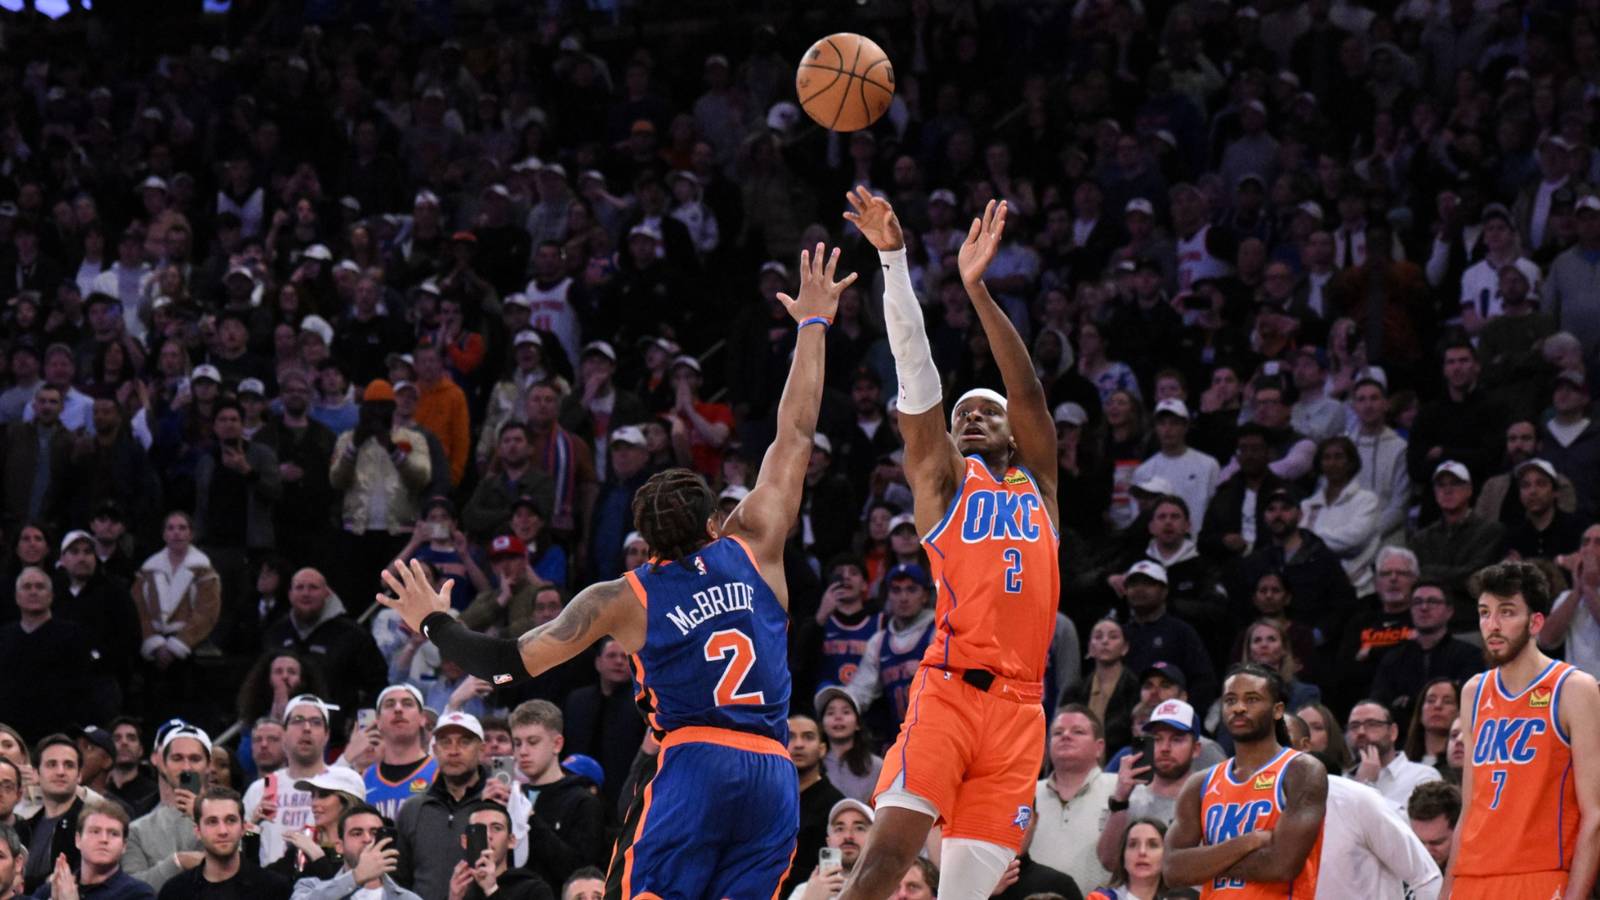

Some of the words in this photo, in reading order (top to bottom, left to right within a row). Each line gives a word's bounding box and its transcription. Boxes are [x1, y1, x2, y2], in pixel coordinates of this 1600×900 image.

[961, 488, 1041, 544] OKC
[1003, 547, 1023, 594] 2
[666, 582, 755, 636] McBRIDE
[1360, 626, 1411, 645] Knick
[704, 628, 765, 707] 2
[1472, 717, 1547, 767] OKC
[1489, 769, 1508, 811] 7
[1205, 799, 1273, 847] OKC
